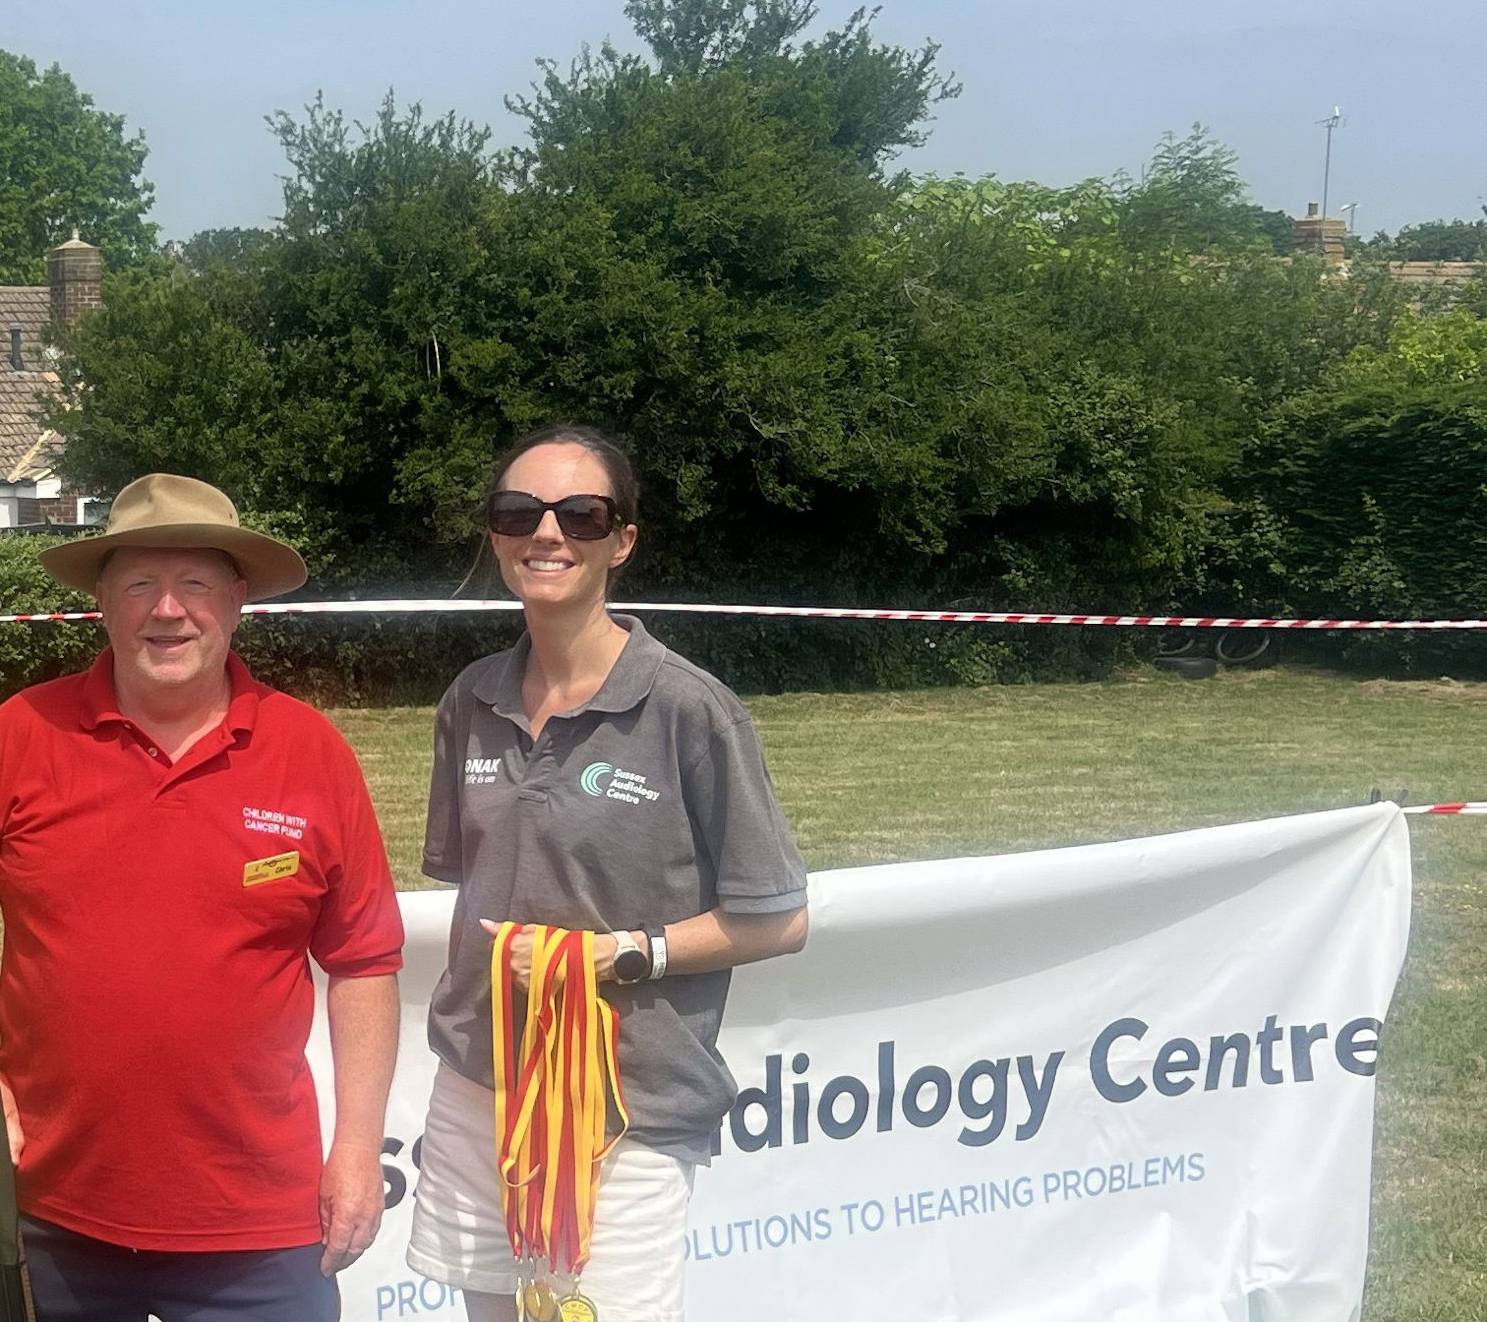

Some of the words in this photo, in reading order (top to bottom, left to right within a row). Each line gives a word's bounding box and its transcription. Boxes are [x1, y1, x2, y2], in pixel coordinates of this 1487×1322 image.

[464, 758, 502, 774] ONAK
[613, 767, 647, 785] Sussex
[606, 789, 640, 805] Centre
[609, 779, 660, 801] Audiology
[243, 807, 285, 822] CHILDREN
[286, 815, 307, 828] WITH
[245, 820, 280, 834] CANCER
[281, 827, 303, 840] FUND
[710, 1040, 1066, 1156] diology
[1090, 1014, 1384, 1103] Centre
[684, 1208, 833, 1262] LUTIONS
[840, 1200, 885, 1234] TO
[894, 1176, 1035, 1228] HEARING
[1043, 1153, 1206, 1203] PROBLEMS
